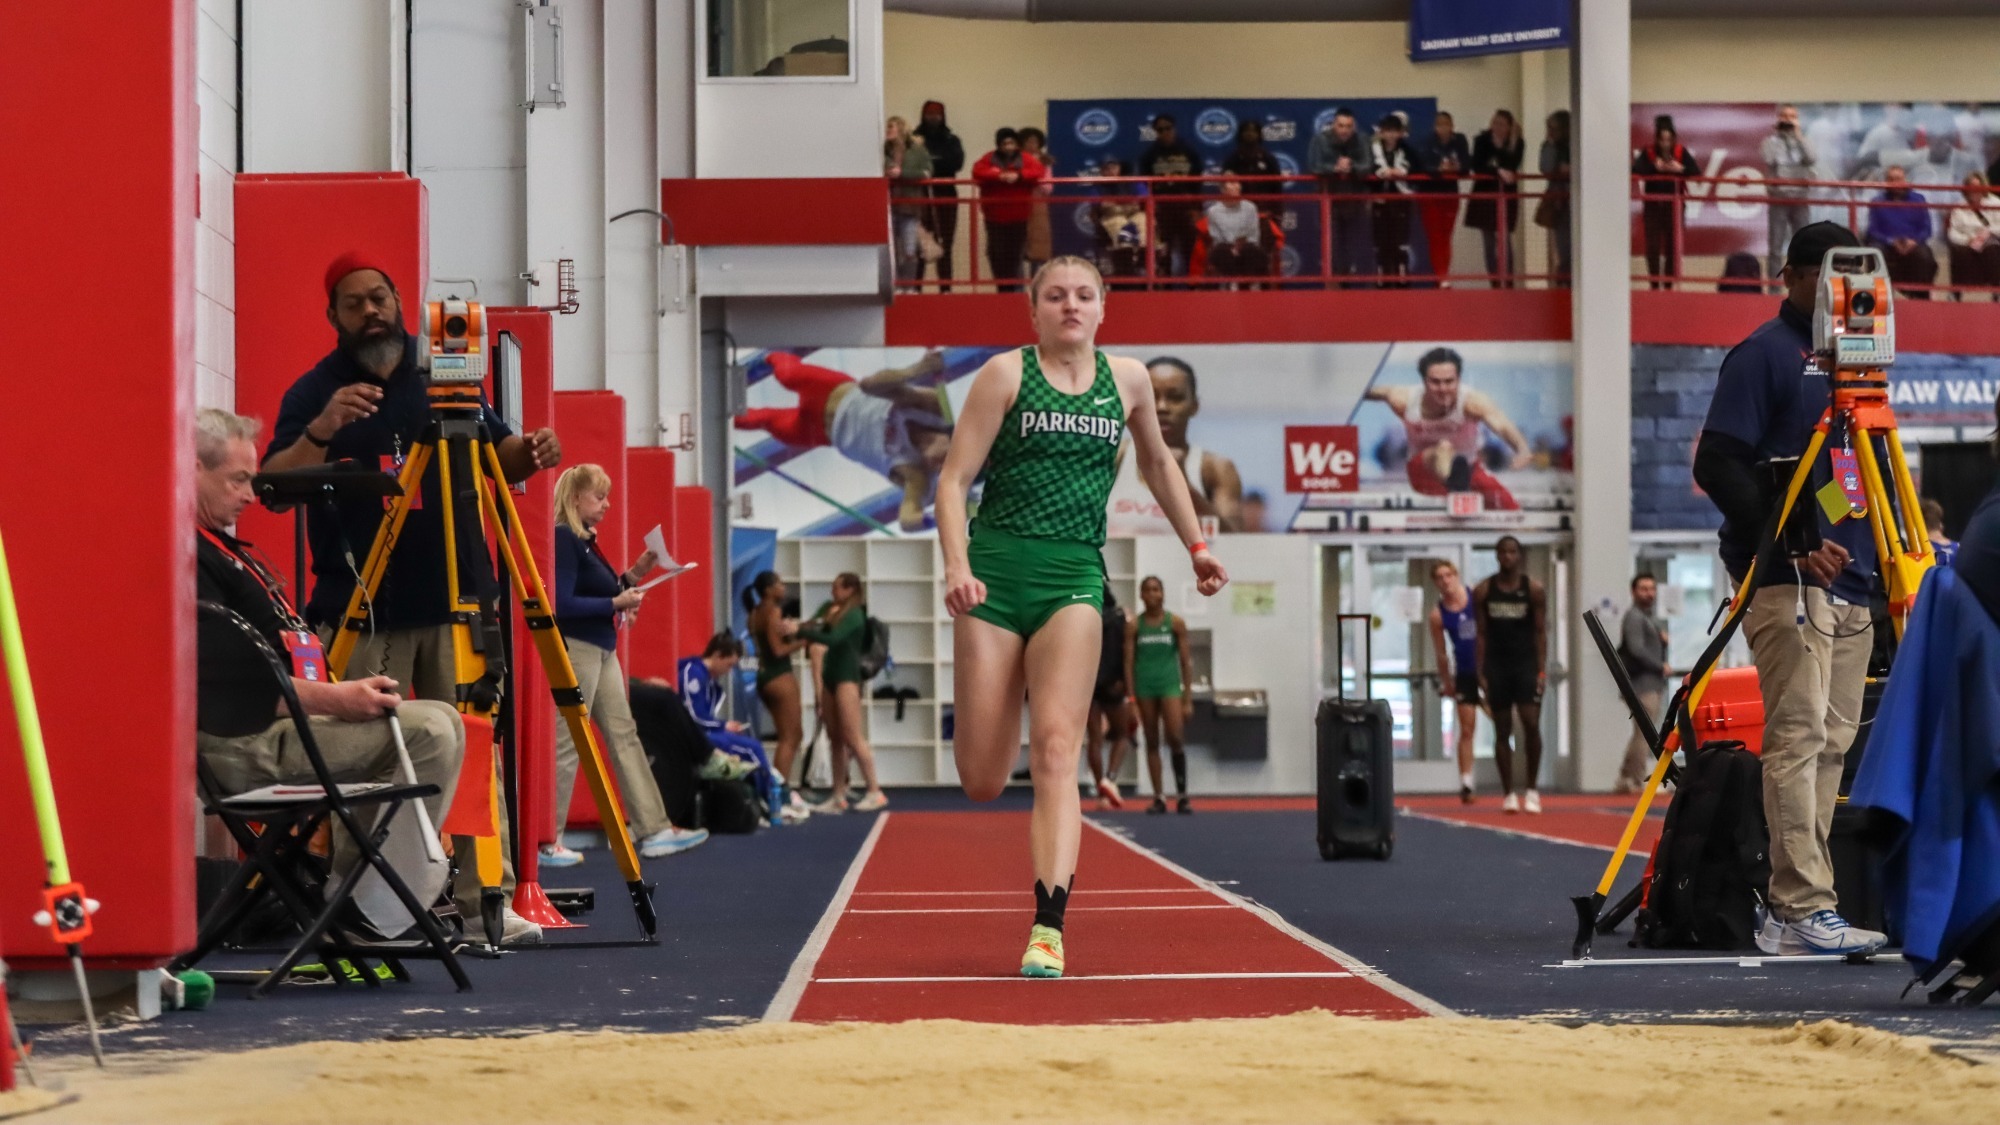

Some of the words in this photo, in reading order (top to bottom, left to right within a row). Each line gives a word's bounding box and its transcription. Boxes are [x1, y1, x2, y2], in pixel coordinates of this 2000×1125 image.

[1460, 34, 1489, 47] VALLEY
[1489, 32, 1514, 45] STATE
[1513, 27, 1561, 42] UNIVERSITY
[1020, 410, 1121, 446] PARKSIDE
[1289, 441, 1356, 476] We
